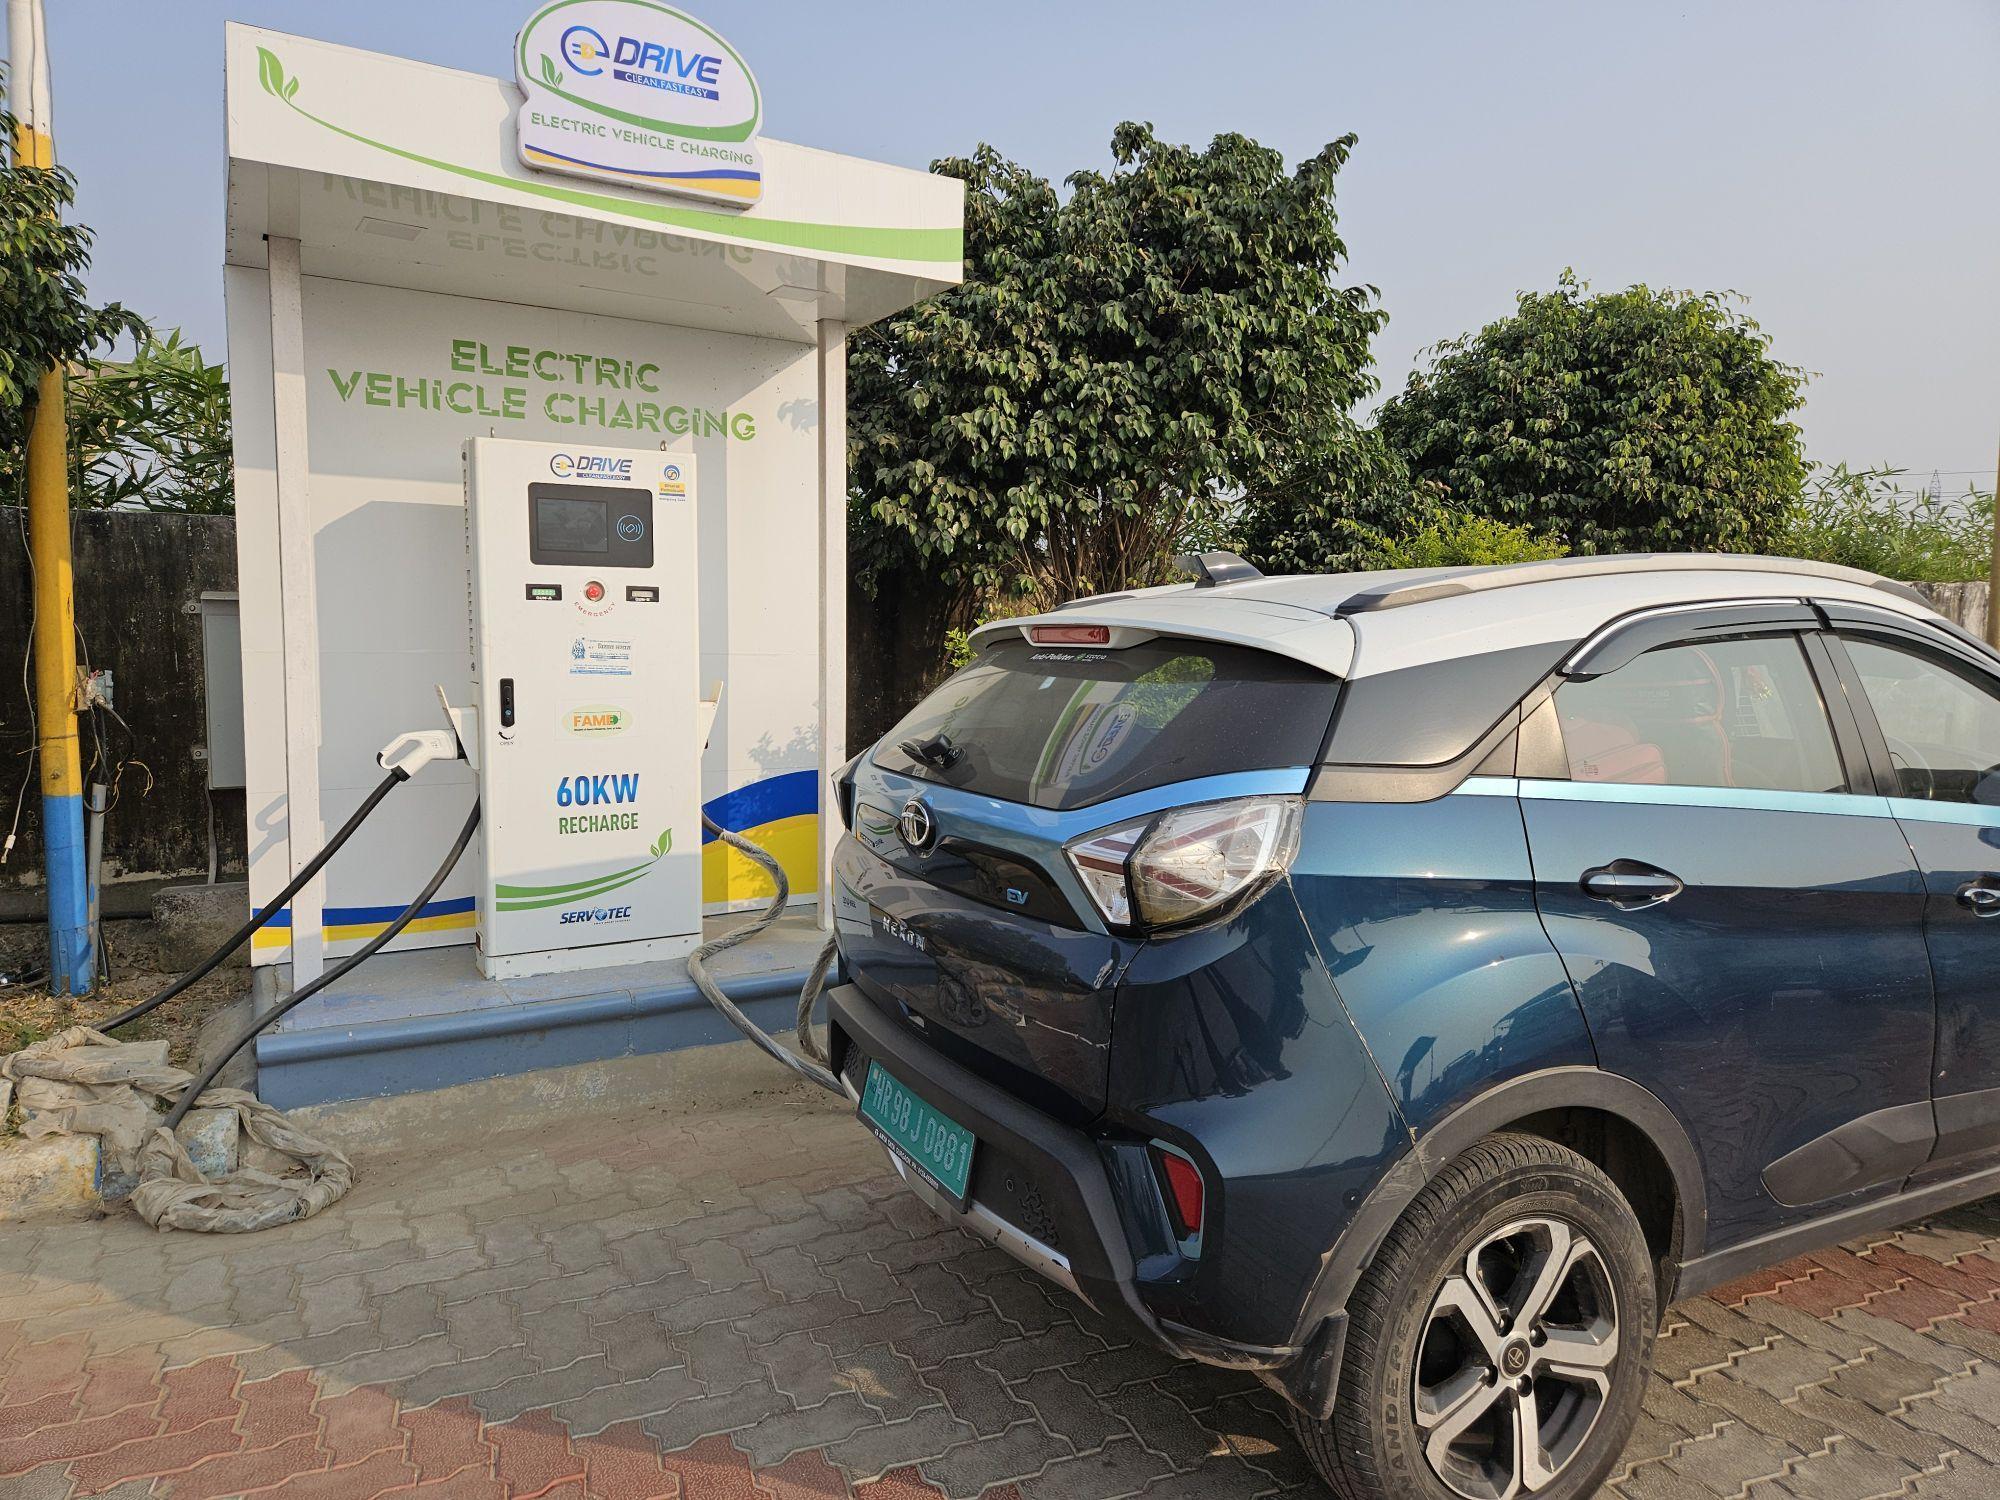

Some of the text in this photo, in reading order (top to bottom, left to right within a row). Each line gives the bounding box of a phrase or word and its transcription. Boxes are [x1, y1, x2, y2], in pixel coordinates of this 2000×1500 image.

[625, 72, 708, 98] CLEAN.FAST.EASY
[531, 112, 754, 165] ELECTRIC VEHICLE CHARGING
[451, 338, 661, 393] ELECTRIC
[327, 368, 756, 441] VEHICLE CHARGING
[574, 601, 616, 617] EMERGENCY
[556, 773, 639, 807] 60KW
[559, 812, 639, 835] RECHARGE
[1006, 887, 1028, 905] EV
[872, 1072, 893, 1118] HR
[910, 1108, 924, 1142] J
